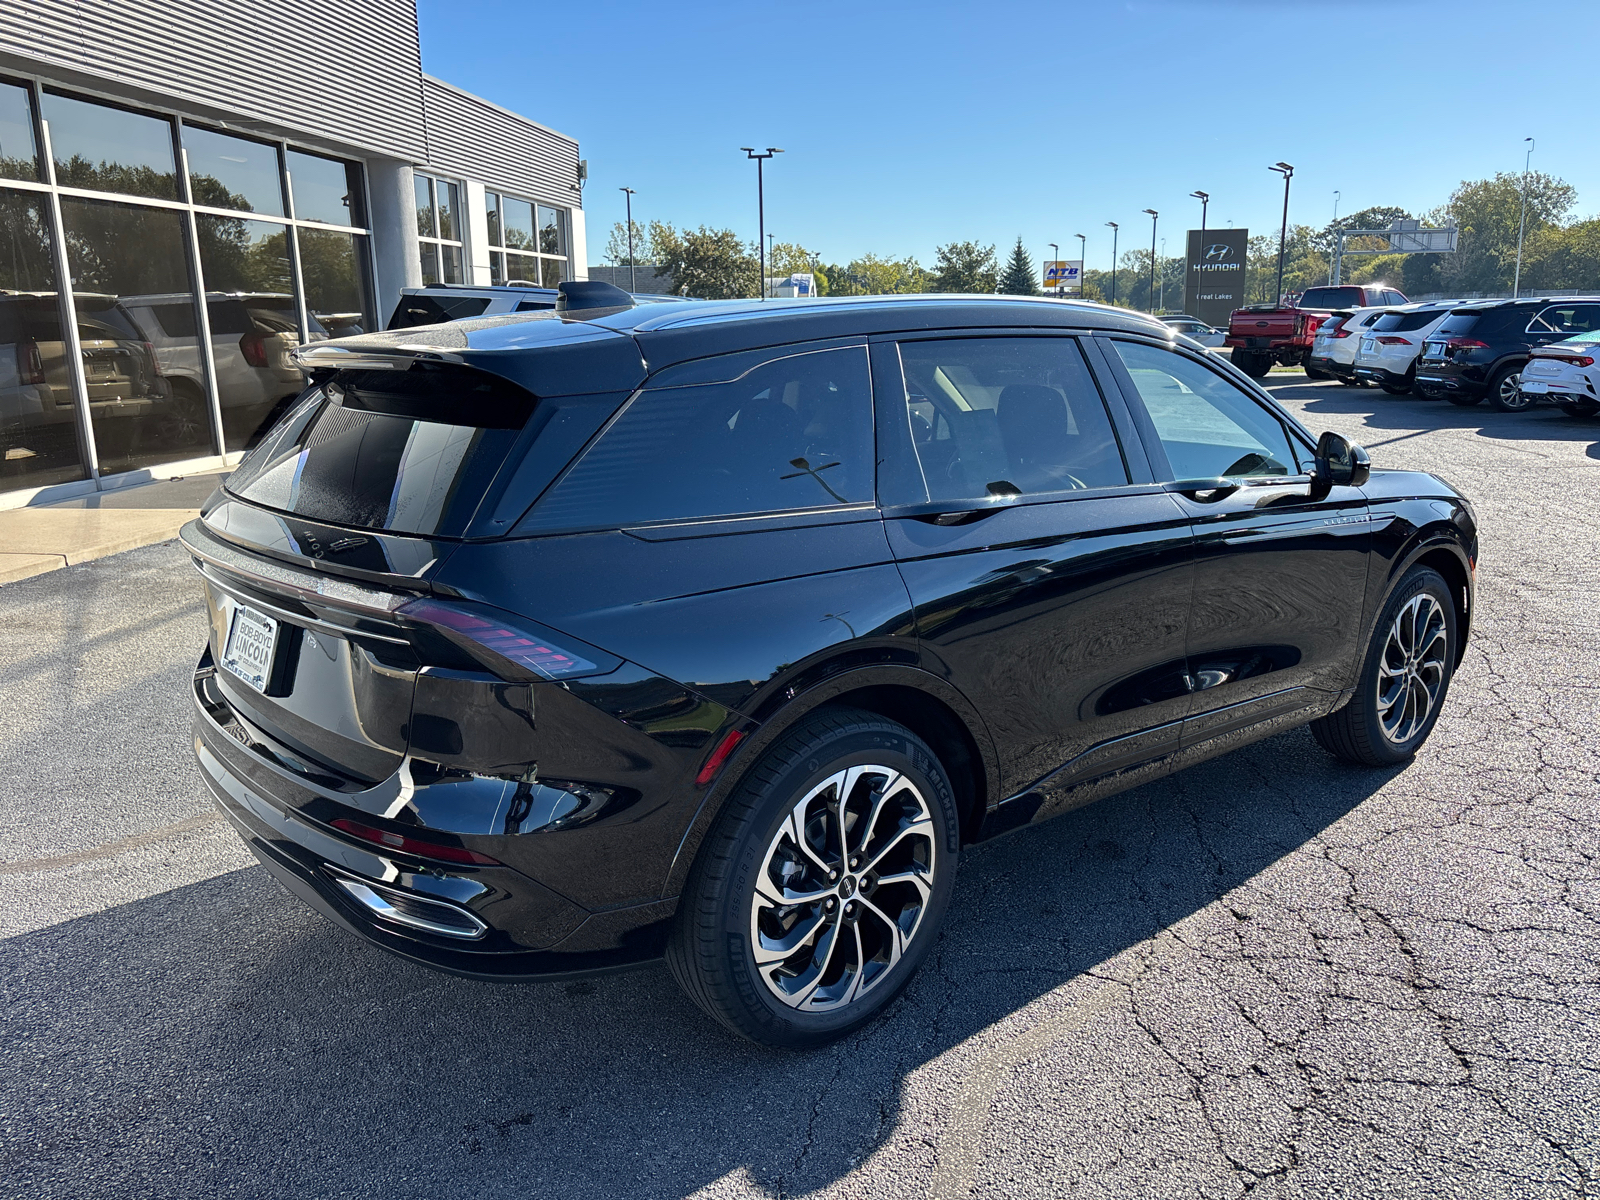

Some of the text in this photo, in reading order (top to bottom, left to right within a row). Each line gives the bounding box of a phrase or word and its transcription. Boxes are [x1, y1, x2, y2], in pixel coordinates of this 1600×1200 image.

[1193, 263, 1240, 272] HYUNDAI
[235, 634, 269, 666] LINCOLN
[928, 768, 957, 850] MICHELIN
